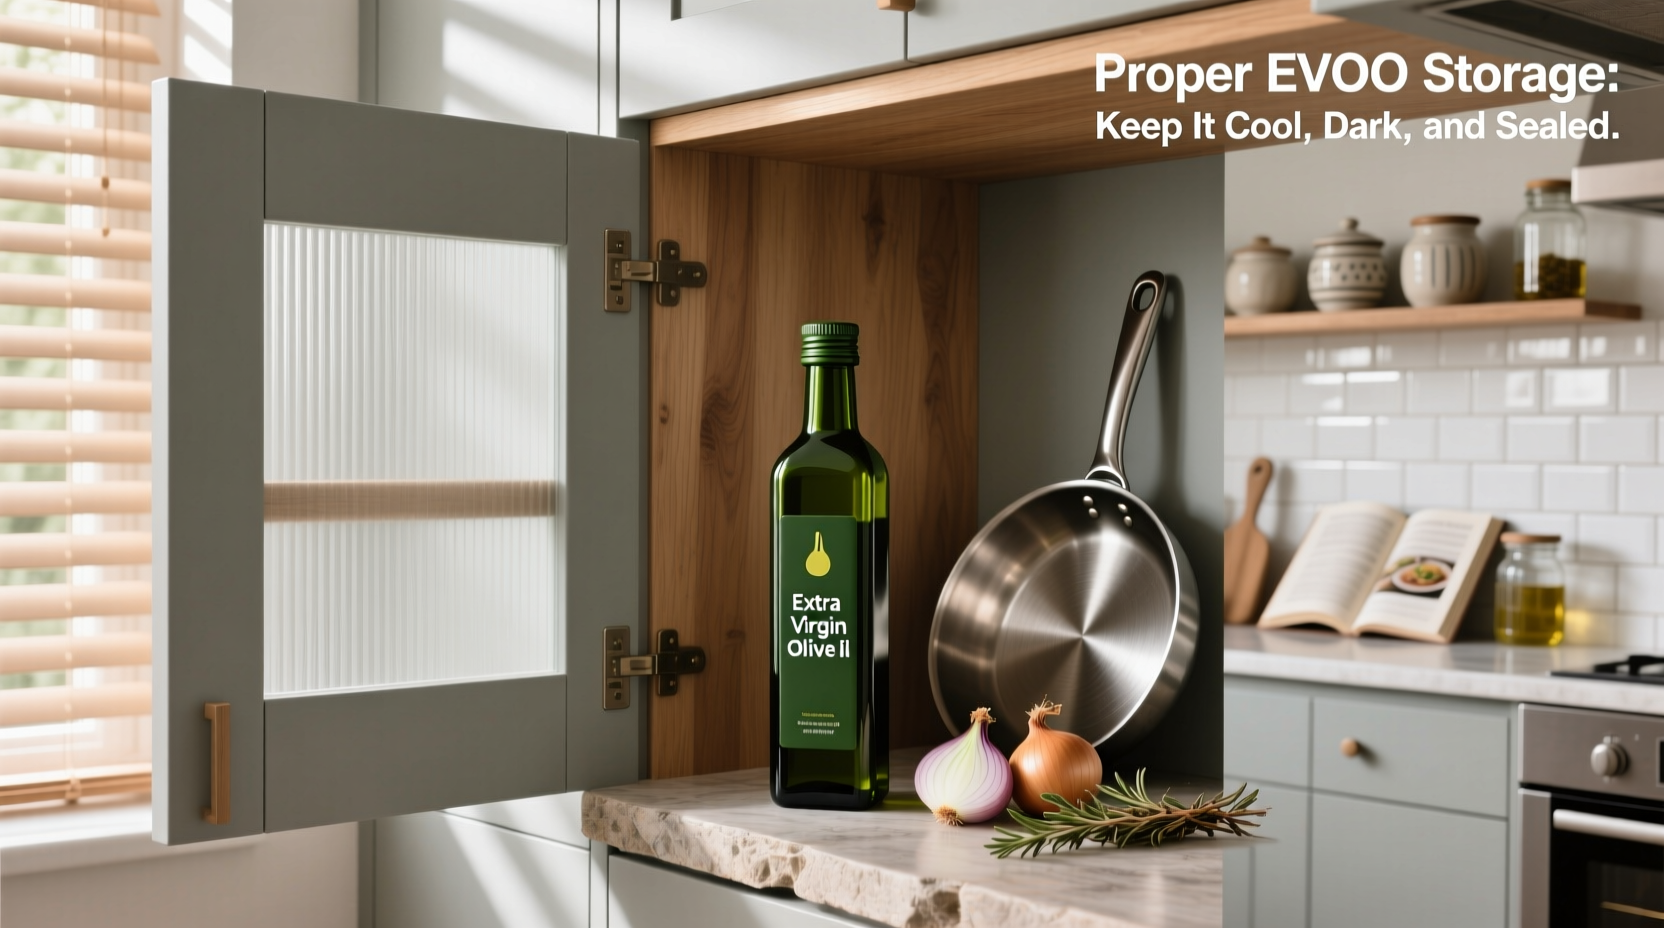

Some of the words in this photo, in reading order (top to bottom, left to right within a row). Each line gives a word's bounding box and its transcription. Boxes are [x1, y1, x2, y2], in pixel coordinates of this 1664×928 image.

[792, 593, 841, 612] Extra
[790, 615, 847, 640] Virgin
[787, 639, 836, 658] Olive
